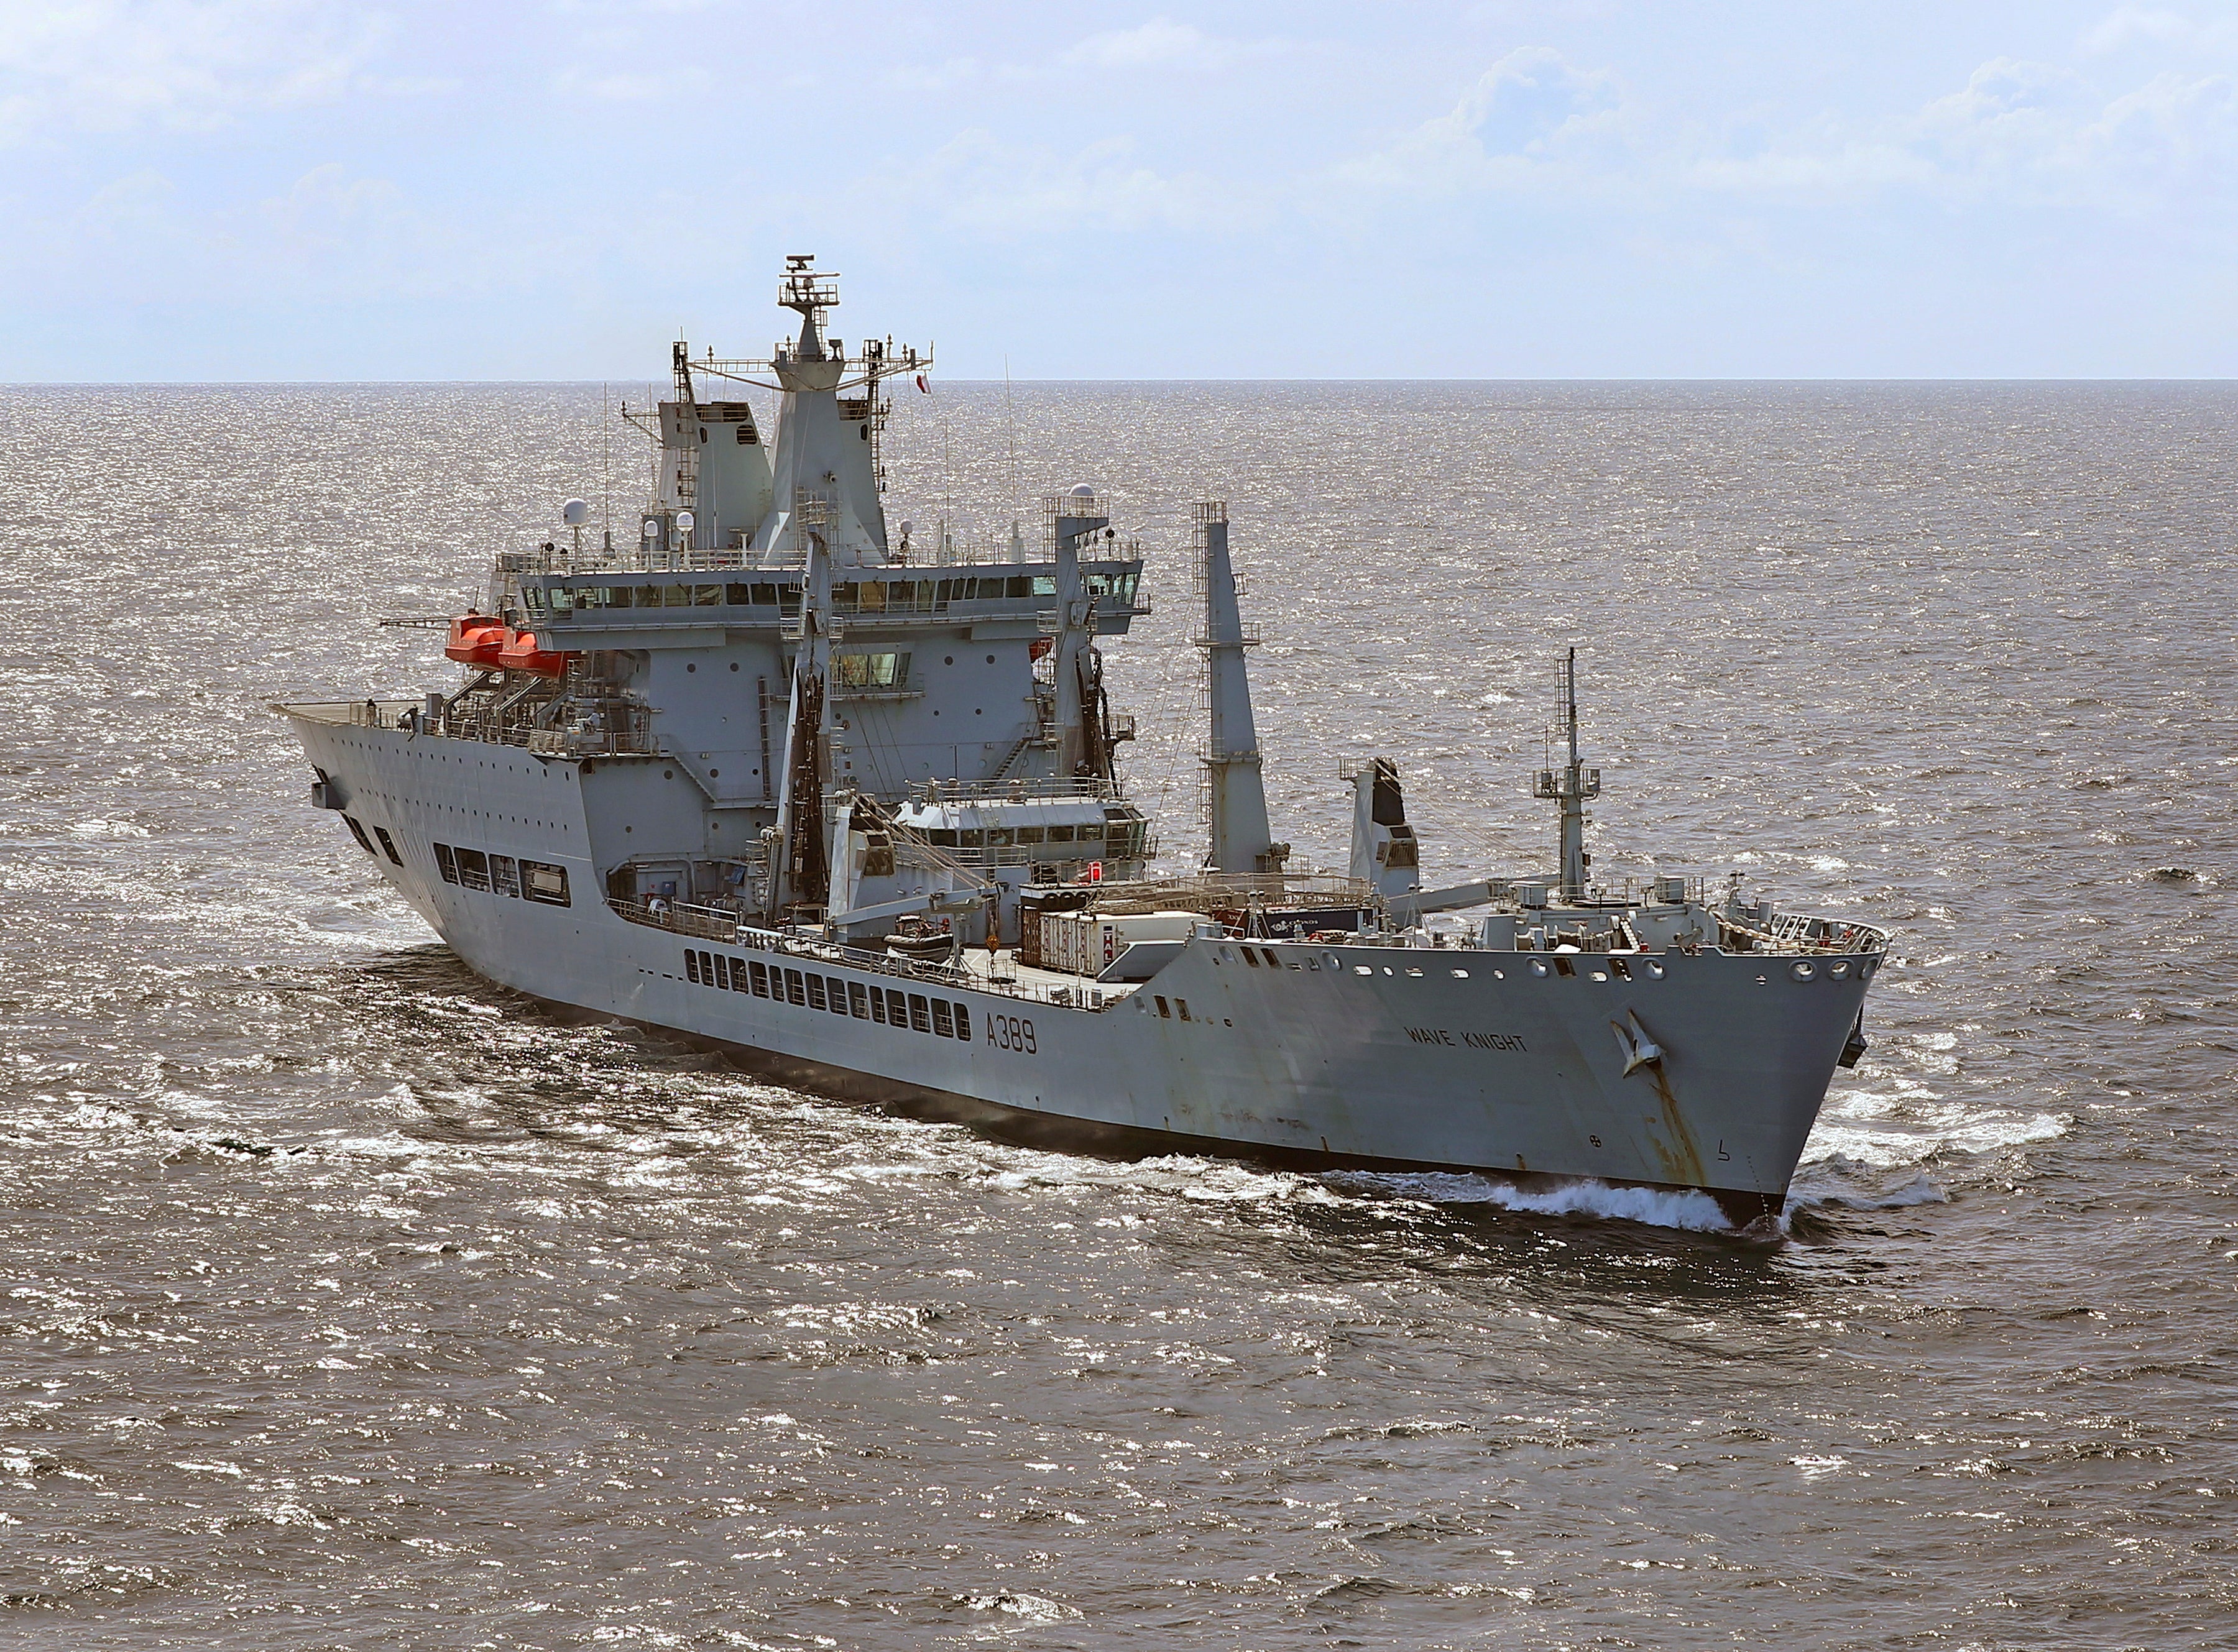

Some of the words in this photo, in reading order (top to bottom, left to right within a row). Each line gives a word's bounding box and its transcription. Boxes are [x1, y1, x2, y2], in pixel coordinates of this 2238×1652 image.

[1103, 932, 1113, 961] TAL
[987, 1012, 1037, 1055] A389
[1404, 1027, 1456, 1047] WAVE
[1461, 1032, 1527, 1052] KNIGHT
